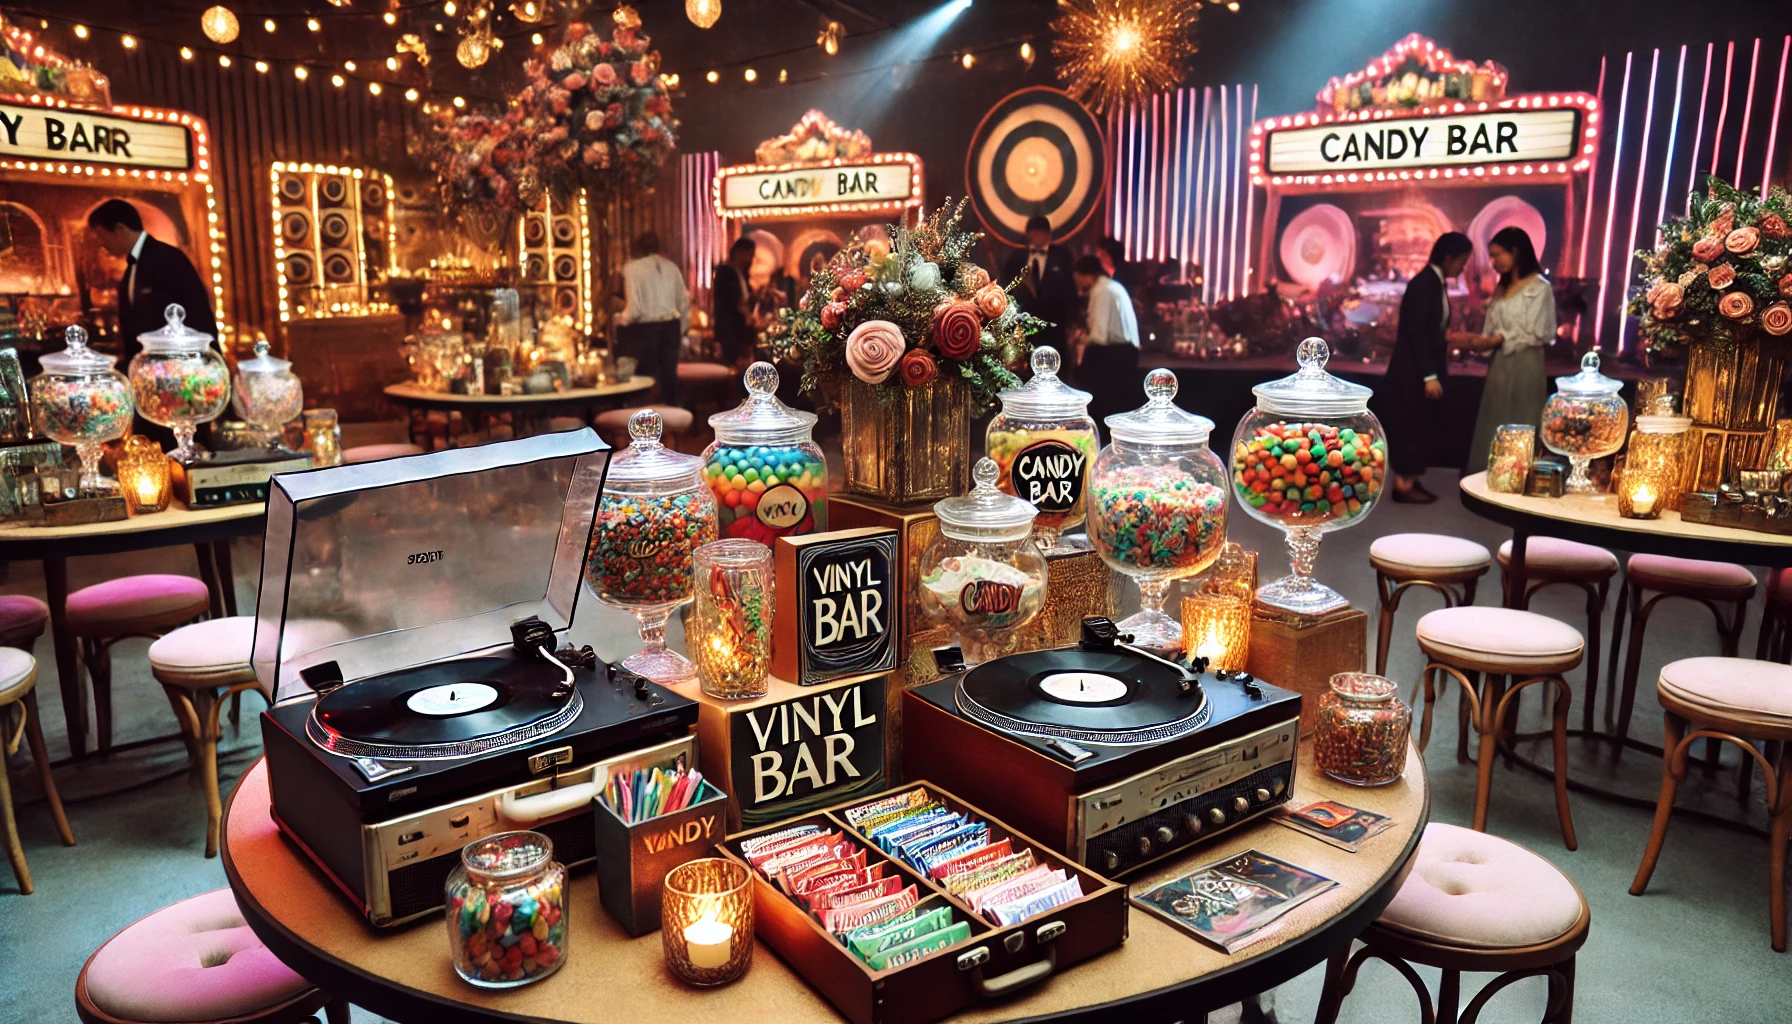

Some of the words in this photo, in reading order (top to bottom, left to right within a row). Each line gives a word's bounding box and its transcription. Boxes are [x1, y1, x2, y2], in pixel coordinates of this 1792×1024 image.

[1320, 126, 1429, 162] CANDY
[1447, 121, 1518, 156] BAR
[837, 171, 879, 196] BAR
[1019, 453, 1086, 480] CANDY
[1029, 480, 1074, 505] BAR
[813, 558, 882, 595] VINYL
[812, 588, 884, 647] BAR
[745, 685, 877, 752] VINYL
[750, 732, 862, 804] BAR
